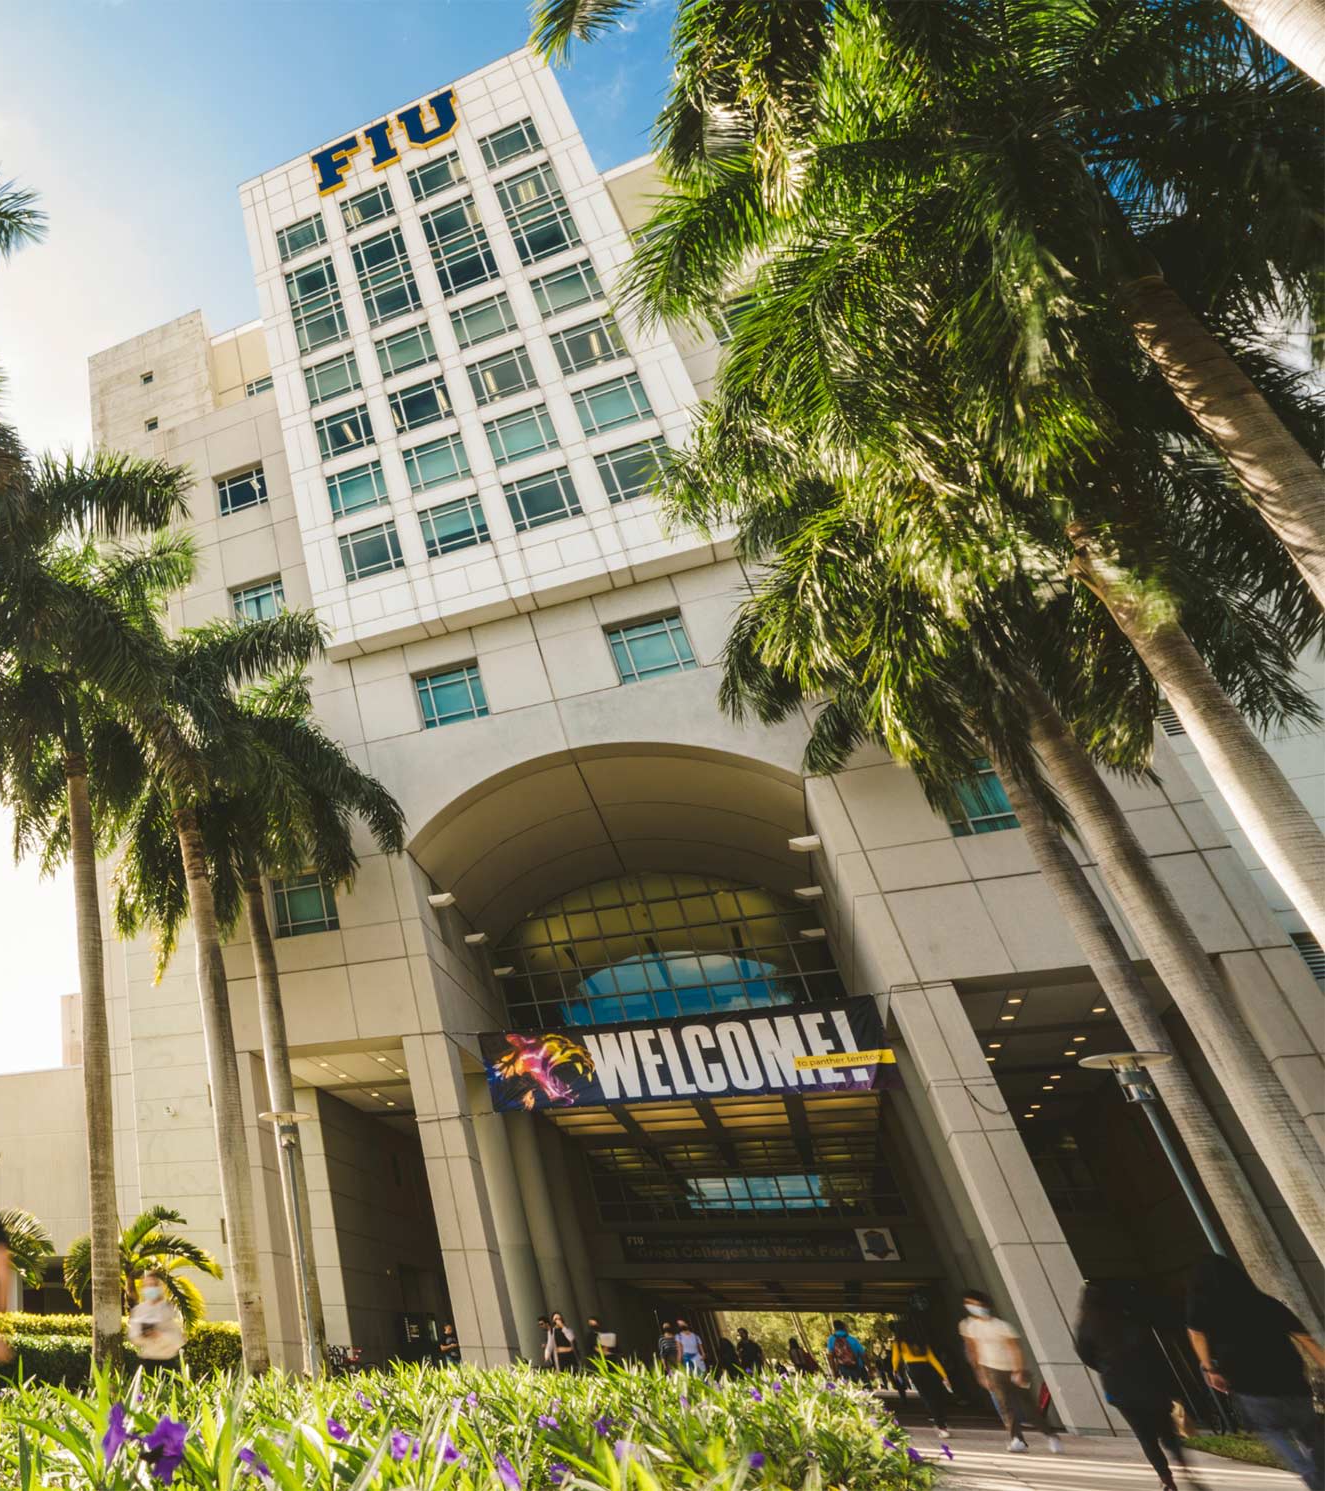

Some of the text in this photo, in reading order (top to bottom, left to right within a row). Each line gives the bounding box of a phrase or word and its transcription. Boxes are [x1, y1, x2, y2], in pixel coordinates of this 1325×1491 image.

[311, 87, 460, 196] FIU
[583, 1010, 870, 1099] WELCOME!
[810, 1057, 844, 1067] panther
[847, 1053, 884, 1063] territory
[626, 1236, 643, 1246] FIU
[752, 1246, 770, 1257] to
[772, 1245, 816, 1257] Work
